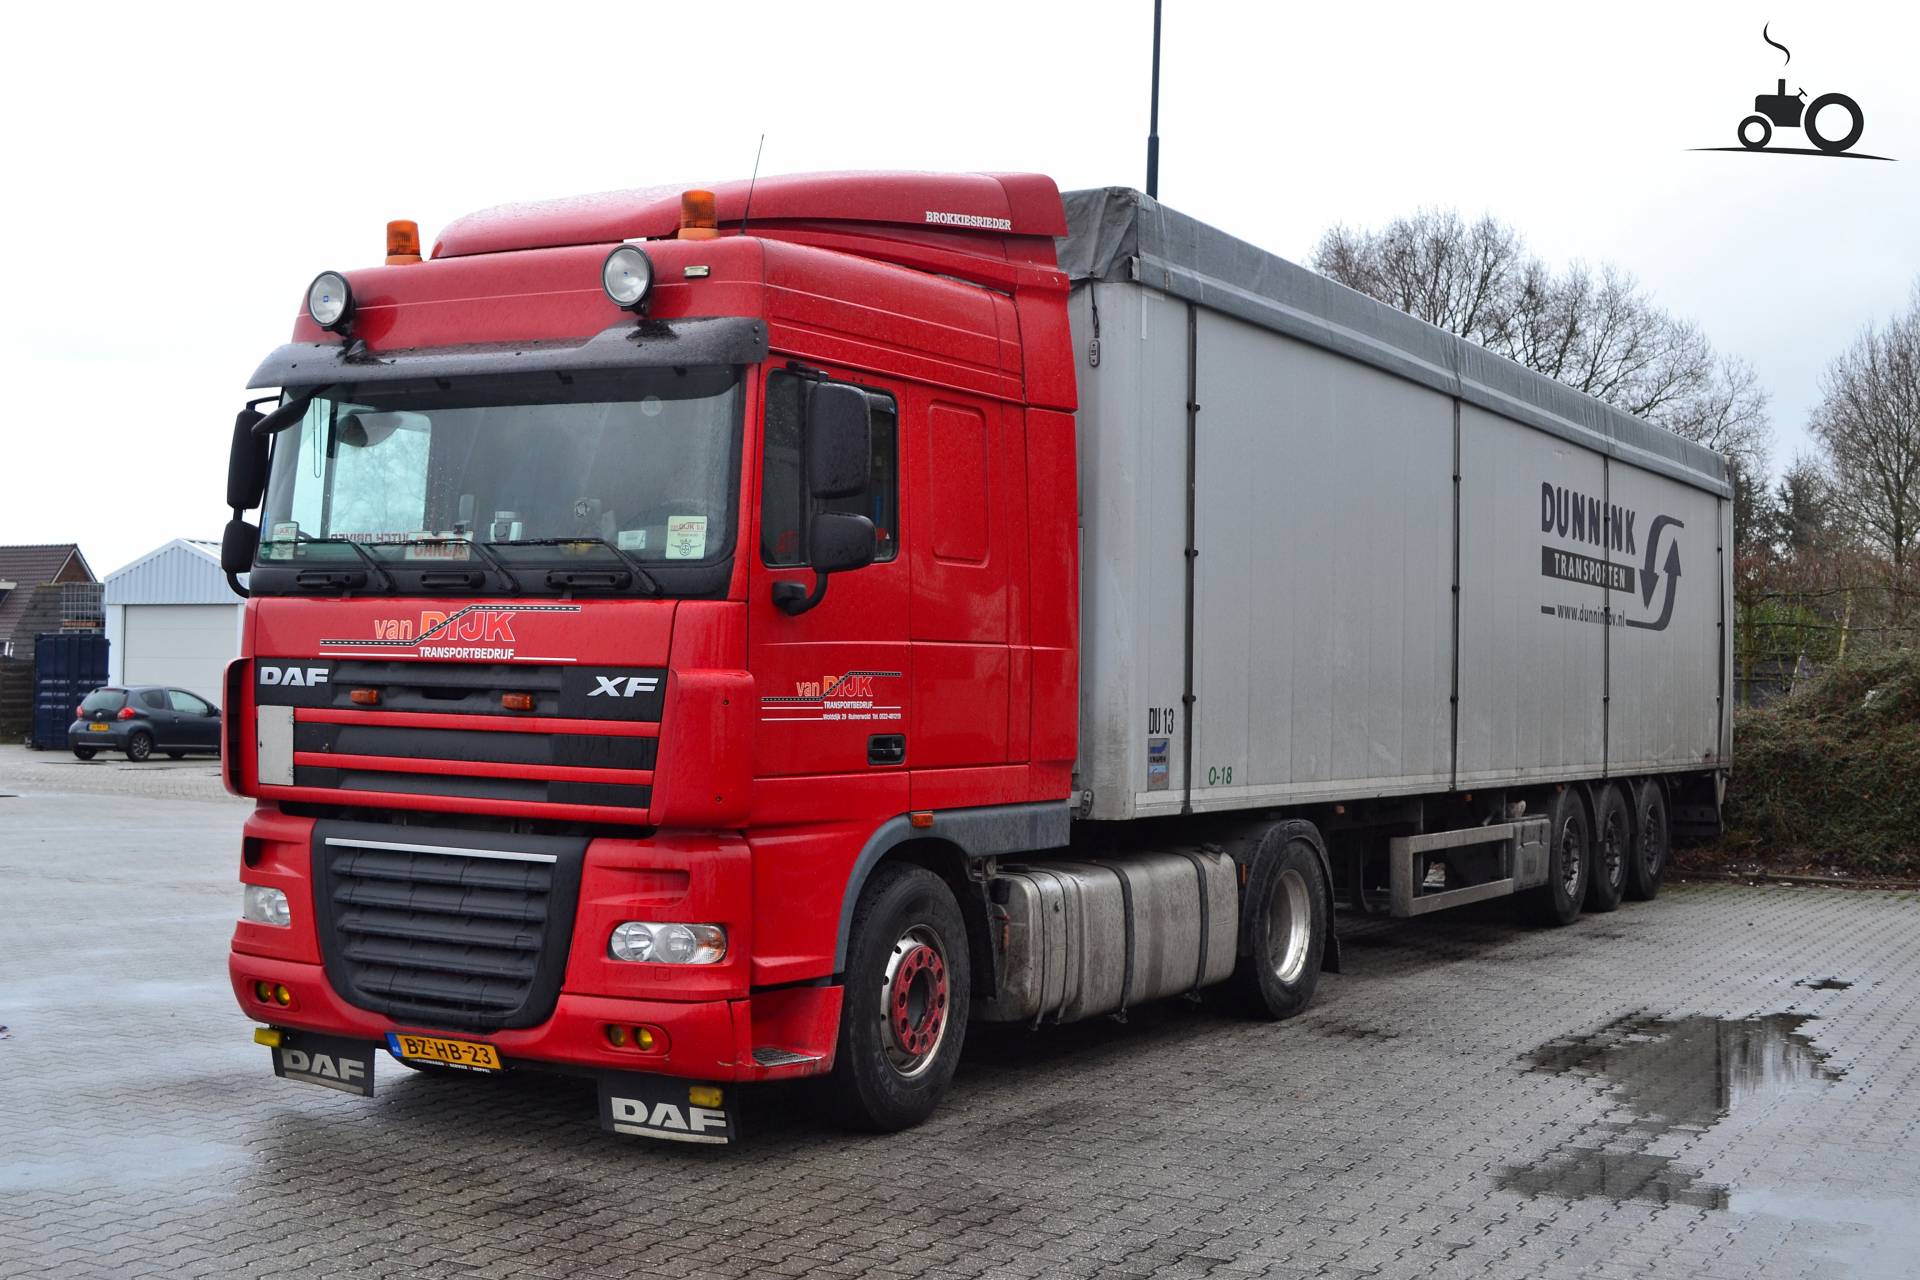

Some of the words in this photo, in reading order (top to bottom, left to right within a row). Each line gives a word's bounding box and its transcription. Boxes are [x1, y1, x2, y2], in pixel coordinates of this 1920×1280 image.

[925, 211, 1011, 230] BROKKIESRIEDER
[1541, 481, 1636, 555] DUNNINK
[374, 619, 413, 640] van
[419, 610, 516, 642] DIJK
[1557, 603, 1625, 627] www.dunninv.nl
[419, 646, 515, 660] TRANSPORTBEDRIJF
[259, 666, 329, 687] DAF
[586, 676, 659, 697] XF
[796, 681, 820, 697] van
[823, 675, 873, 697] DIJK
[823, 701, 873, 709] TRANSPORTBEDRIJF
[1148, 707, 1161, 734] DU
[1163, 707, 1174, 734] 13
[281, 1047, 365, 1080] DAF
[404, 1038, 492, 1065] BZ-HB-23
[611, 1097, 727, 1132] DAF
